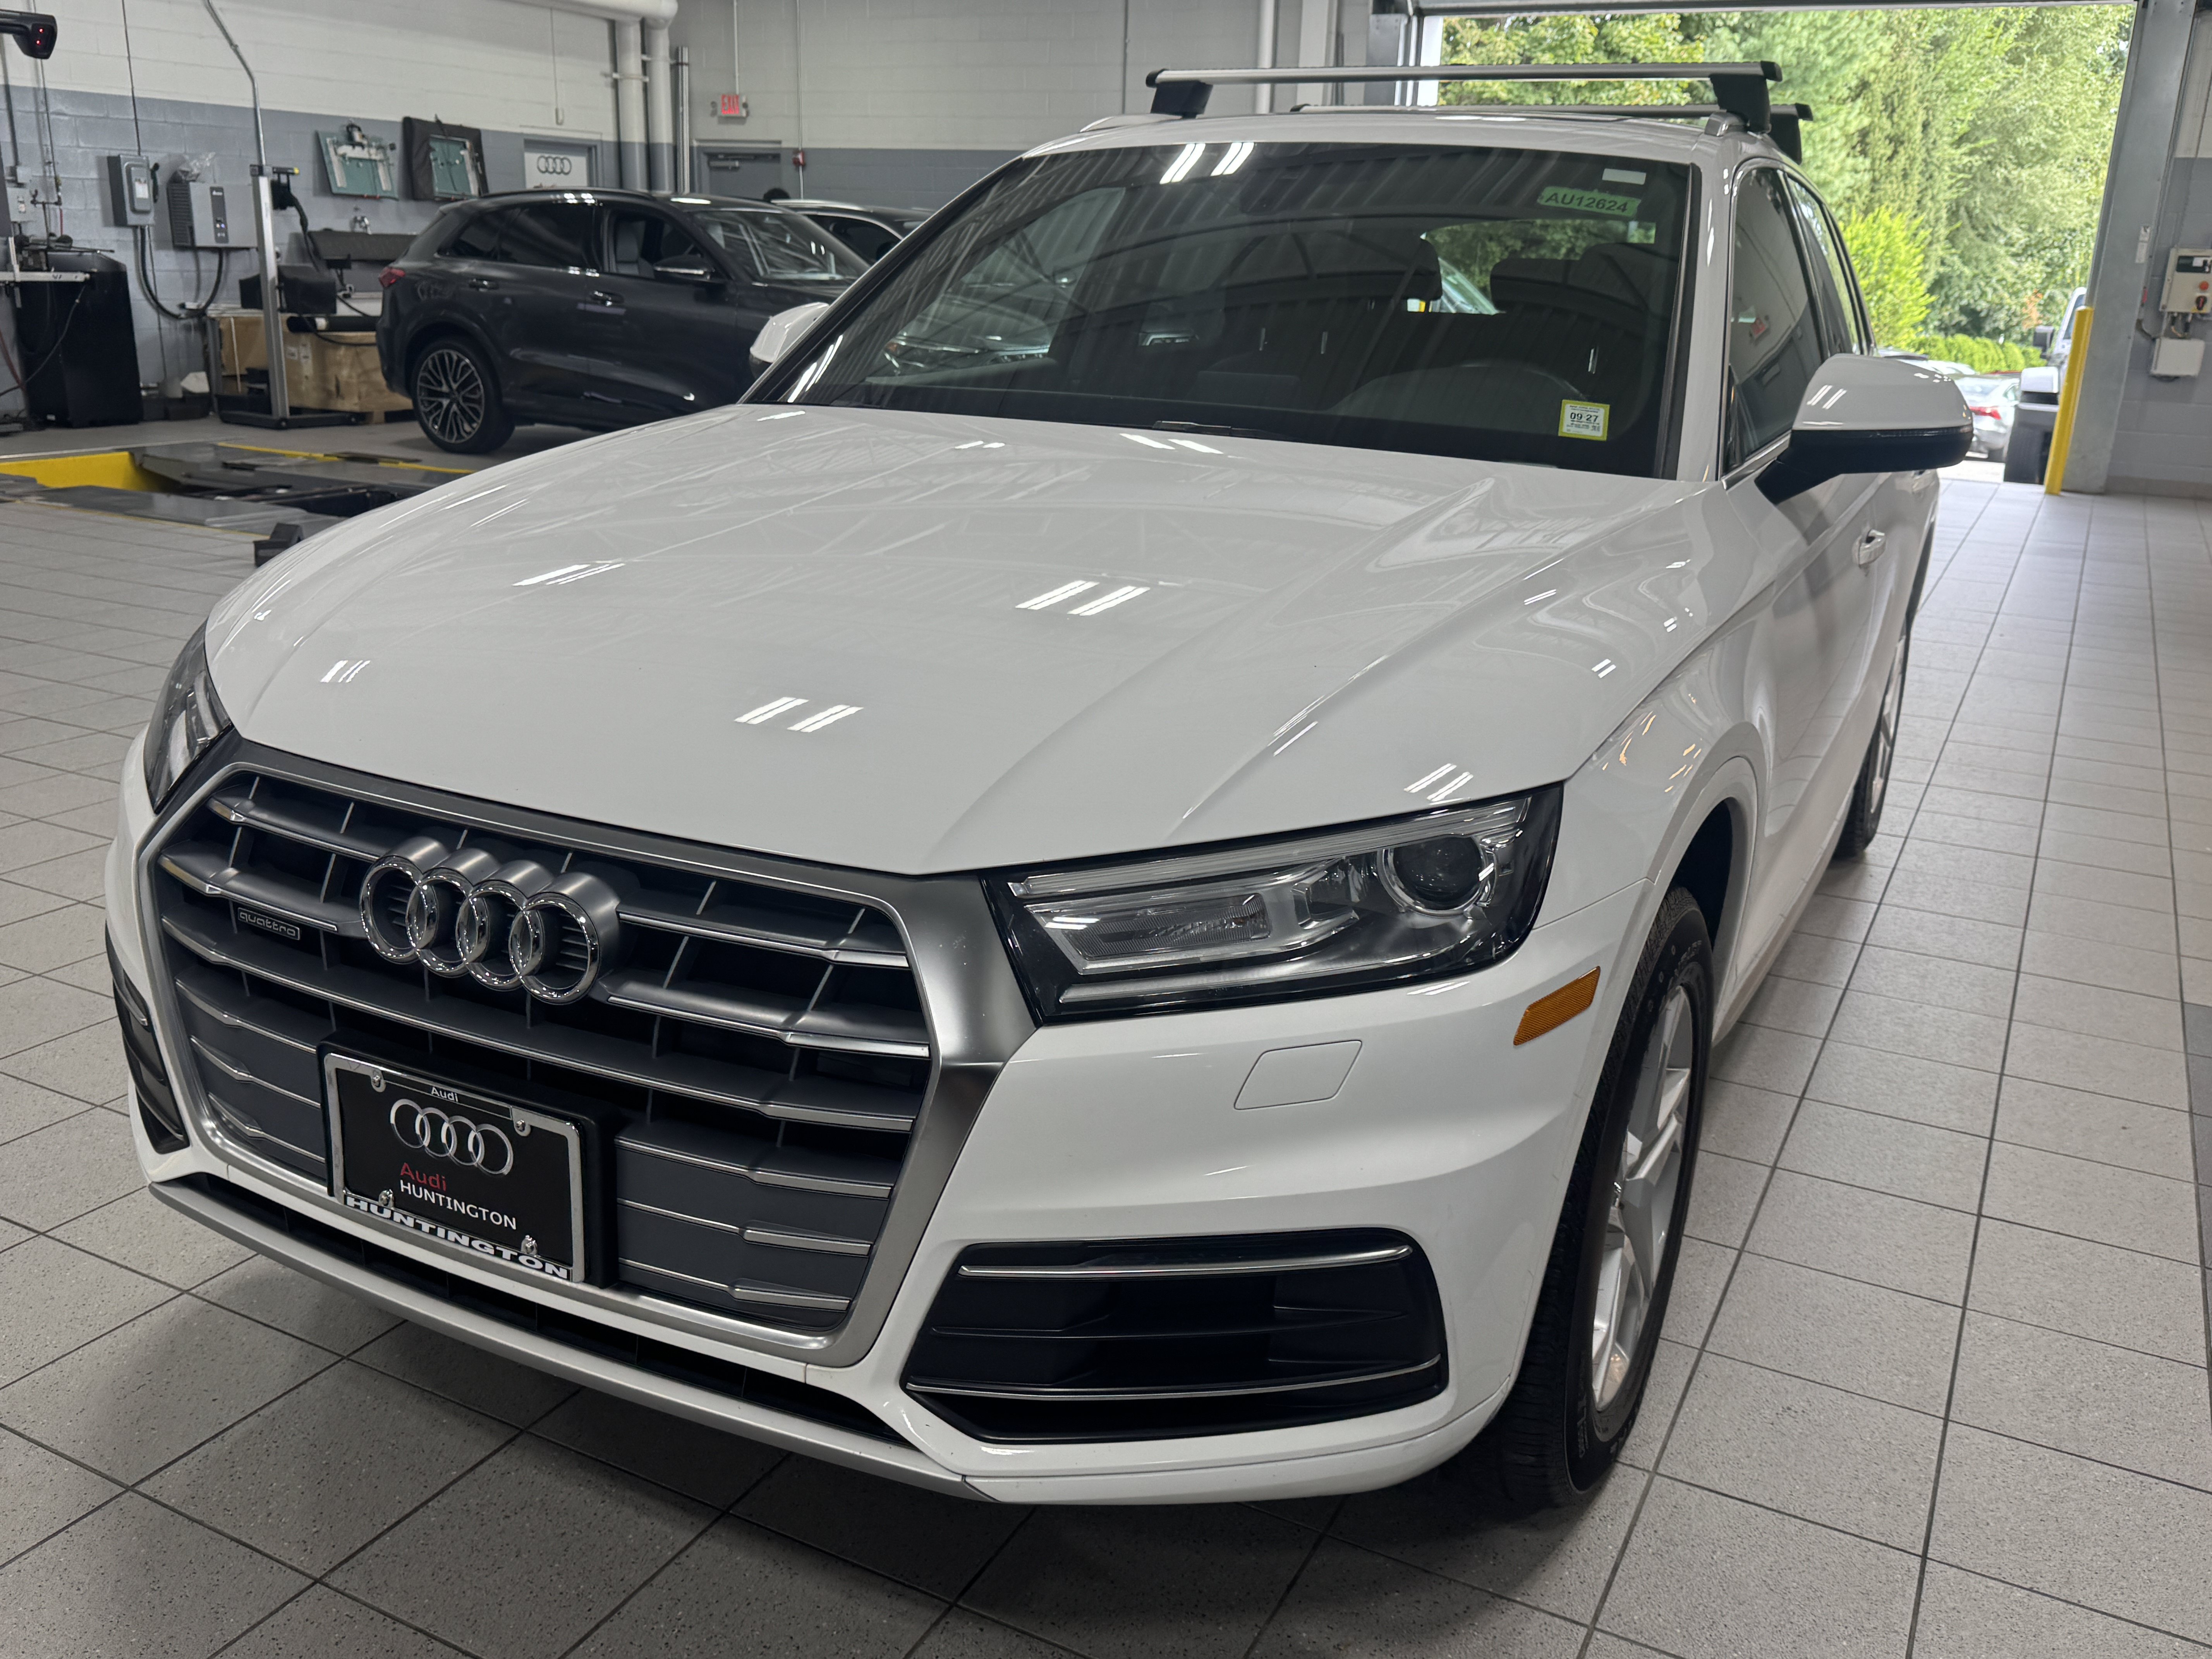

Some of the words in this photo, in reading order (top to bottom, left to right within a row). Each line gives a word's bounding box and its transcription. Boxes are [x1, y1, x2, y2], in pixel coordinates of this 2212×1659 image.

[722, 94, 740, 115] EXIT
[1545, 193, 1628, 212] AU12624
[240, 911, 295, 936] quattro
[431, 1086, 459, 1103] Audi
[400, 1162, 447, 1191] Audi
[400, 1179, 517, 1230] HUNTINGTON
[346, 1195, 568, 1279] HUNTINGTON
